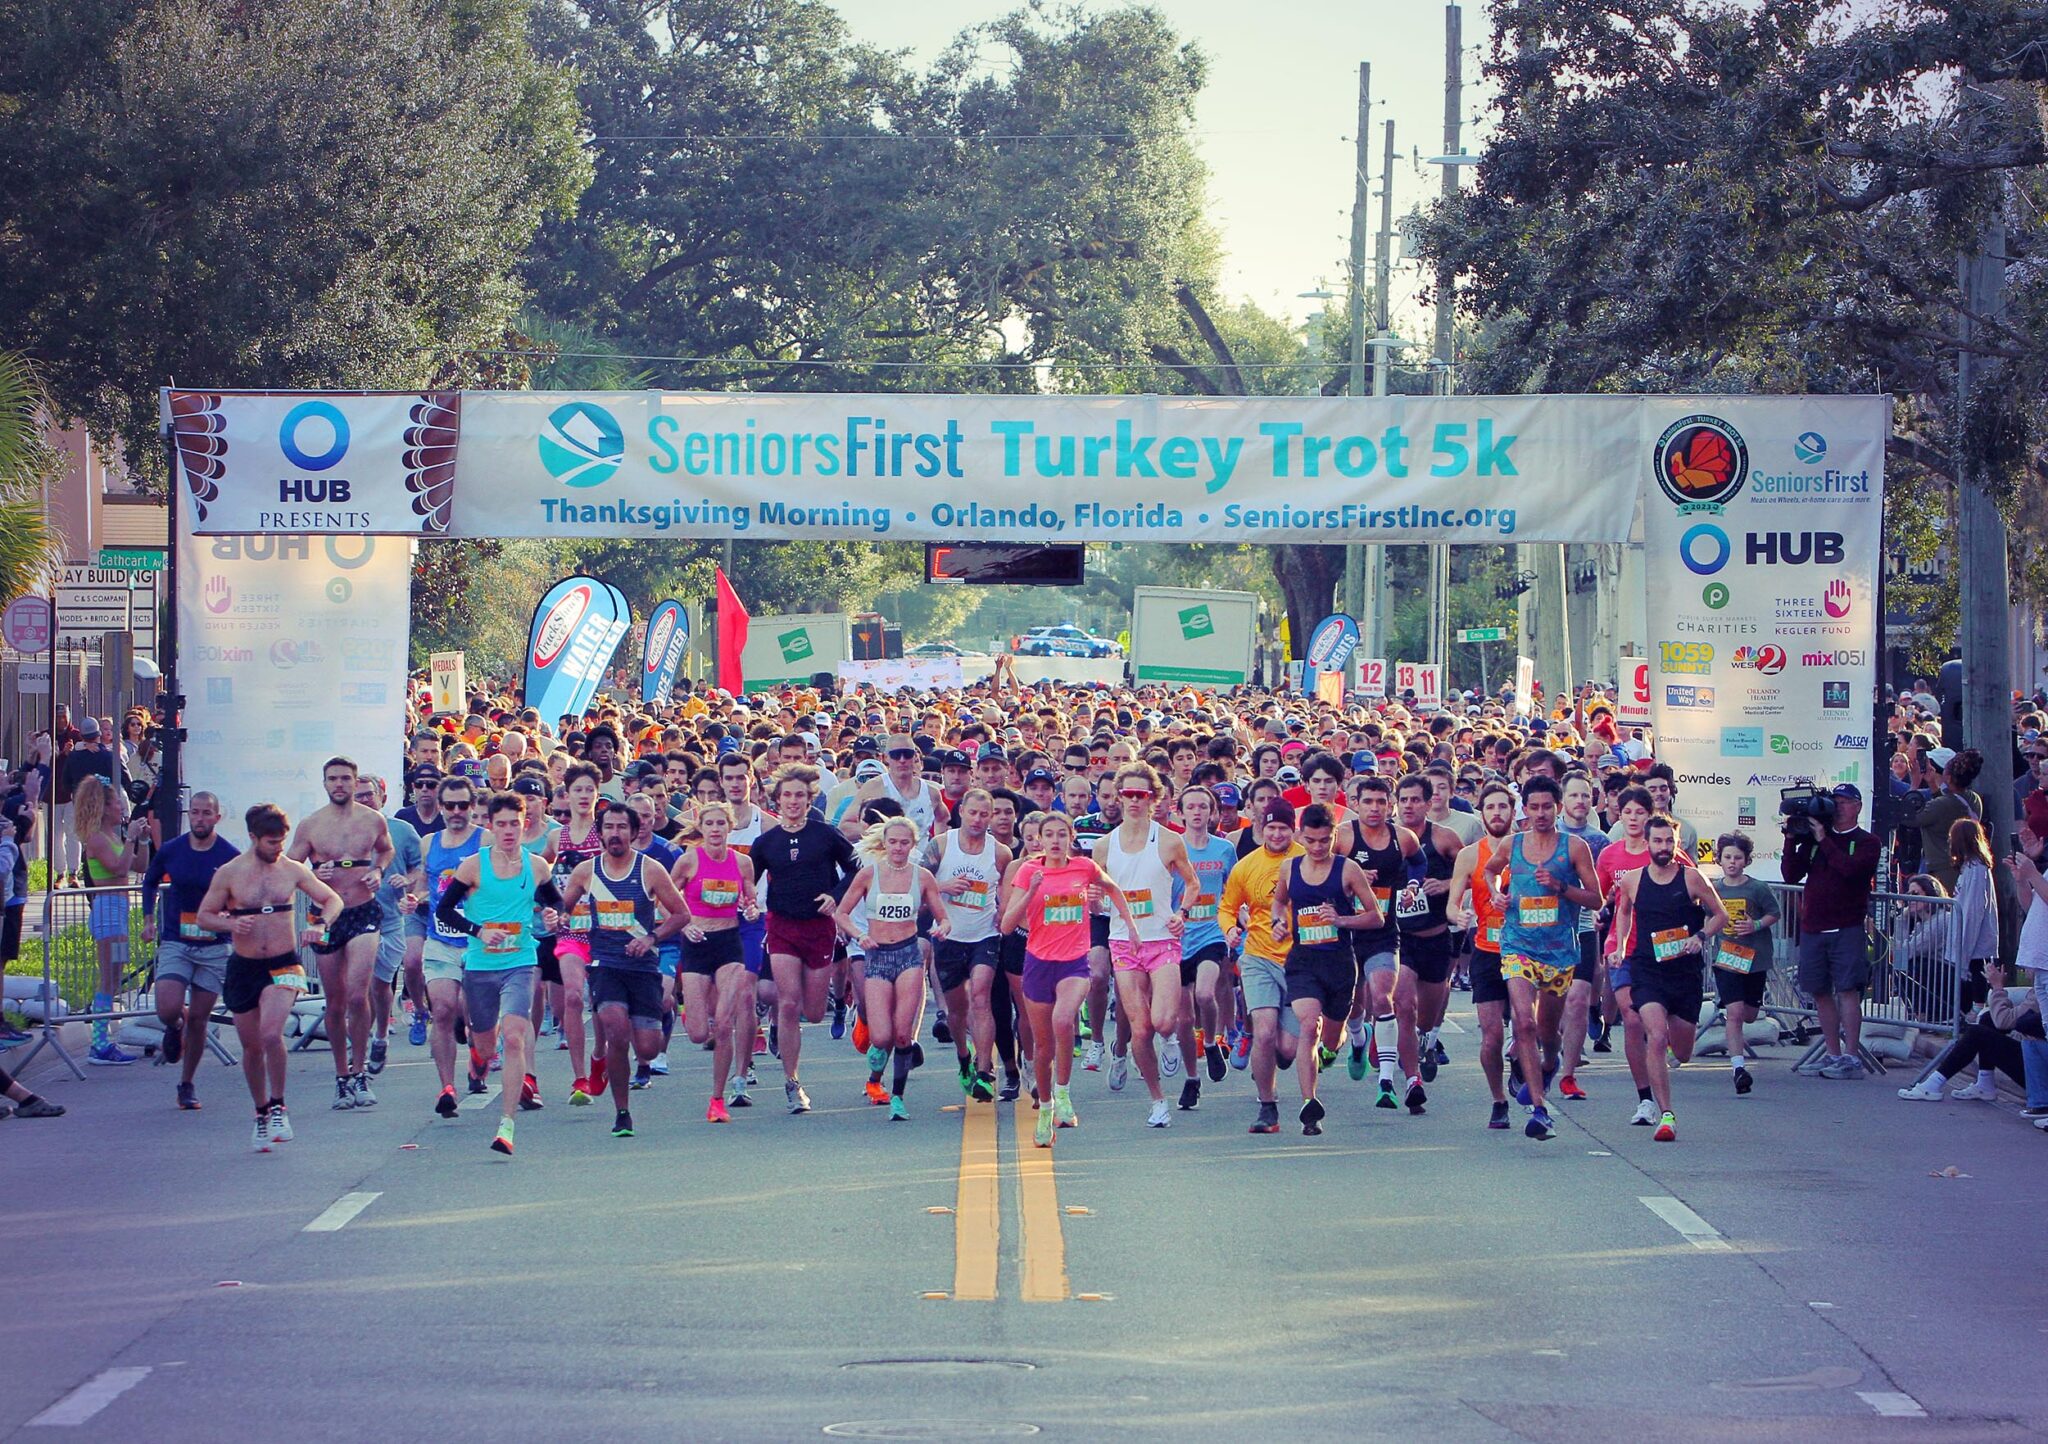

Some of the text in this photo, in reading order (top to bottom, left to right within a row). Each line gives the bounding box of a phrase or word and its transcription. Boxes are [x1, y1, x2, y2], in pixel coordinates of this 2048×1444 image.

[647, 415, 1520, 494] SeniorsFirst Turkey Trot 5k
[1751, 470, 1869, 494] SeniorsFirst
[279, 480, 351, 503] HUB
[259, 512, 370, 529] PRESENTS
[540, 498, 1516, 534] Thanksgiving Morning Orlando, Florida SeniorsFirstInc.org
[1745, 532, 1845, 565] HUB
[100, 554, 148, 567] Cathcart
[152, 559, 161, 568] Av
[1776, 598, 1815, 607] THREE
[1775, 609, 1823, 618] SIXTEEN
[1677, 622, 1757, 634] CHARITIES
[1775, 626, 1851, 635] KEGLER FUND
[561, 612, 611, 679] WATER
[663, 627, 687, 672] WATER
[1658, 641, 1714, 664] 1059
[432, 659, 457, 672] MEDALS
[1760, 645, 1783, 674] 2
[1360, 663, 1382, 684] 12
[1397, 667, 1414, 686] 13
[1420, 670, 1435, 695] 11
[1633, 664, 1650, 703] 9
[1667, 687, 1694, 697] United
[1678, 695, 1695, 706] Way
[1620, 705, 1648, 715] Minute
[1659, 735, 1680, 743] Claris
[1791, 740, 1823, 751] foods
[1834, 734, 1869, 748] MASSEY
[1760, 775, 1787, 783] McCoy
[952, 866, 984, 880] CHICAGO
[879, 905, 911, 919] 4258
[1396, 899, 1426, 914] 436
[599, 911, 632, 926] 3384
[1051, 907, 1077, 921] 2111
[1523, 909, 1554, 923] 2353
[1719, 952, 1749, 971] 3285
